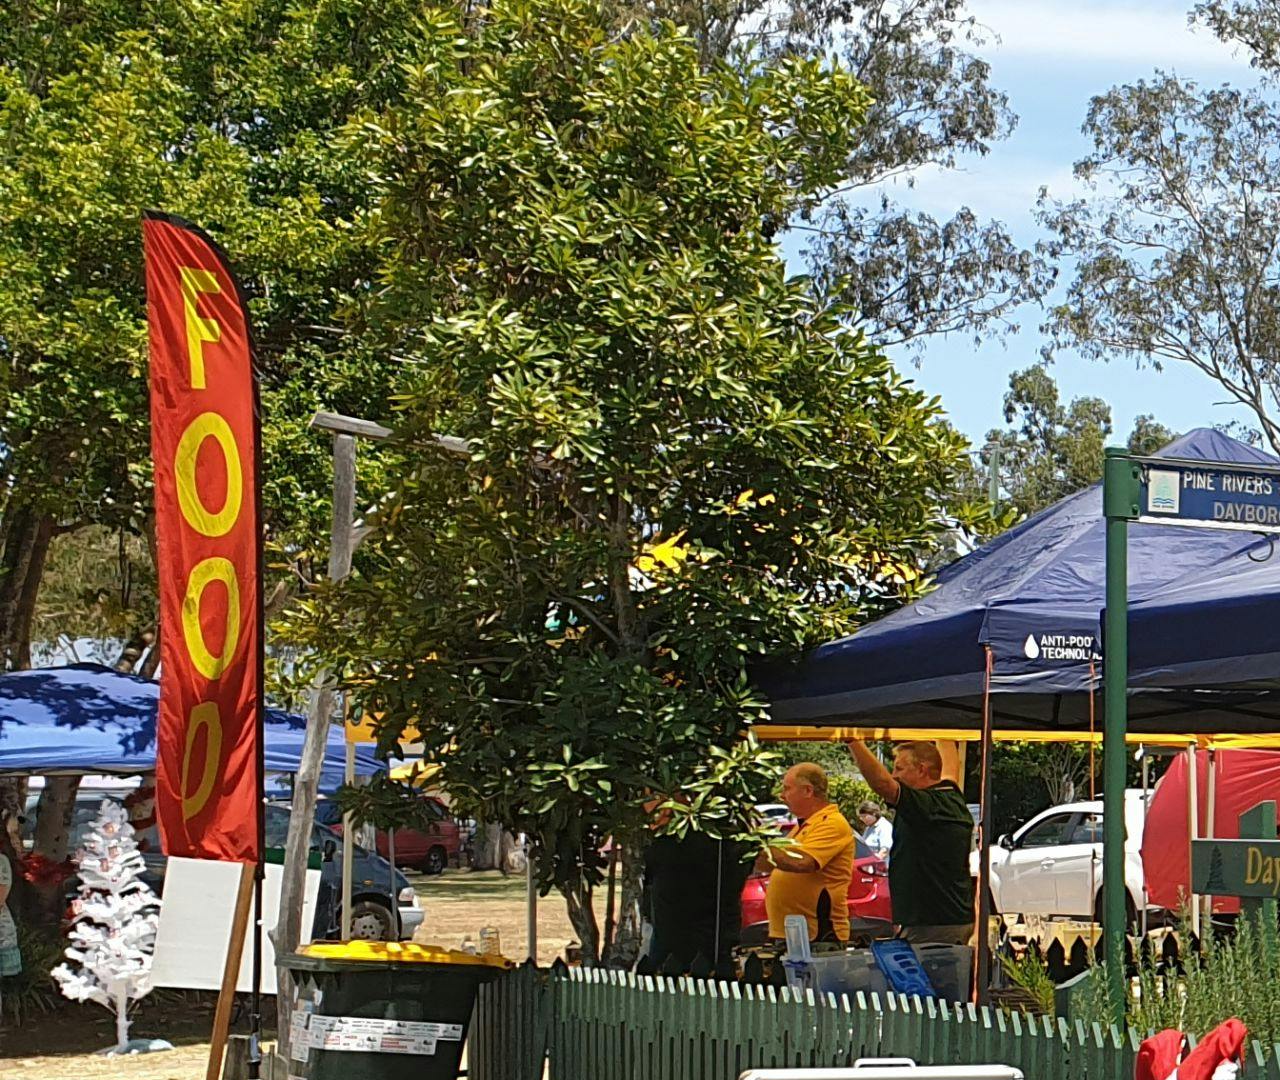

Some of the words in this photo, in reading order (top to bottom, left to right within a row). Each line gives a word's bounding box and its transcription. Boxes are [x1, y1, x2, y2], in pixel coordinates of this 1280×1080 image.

[174, 266, 243, 820] FOOD
[1183, 471, 1215, 491] PINE
[1222, 475, 1272, 495] RIVERS
